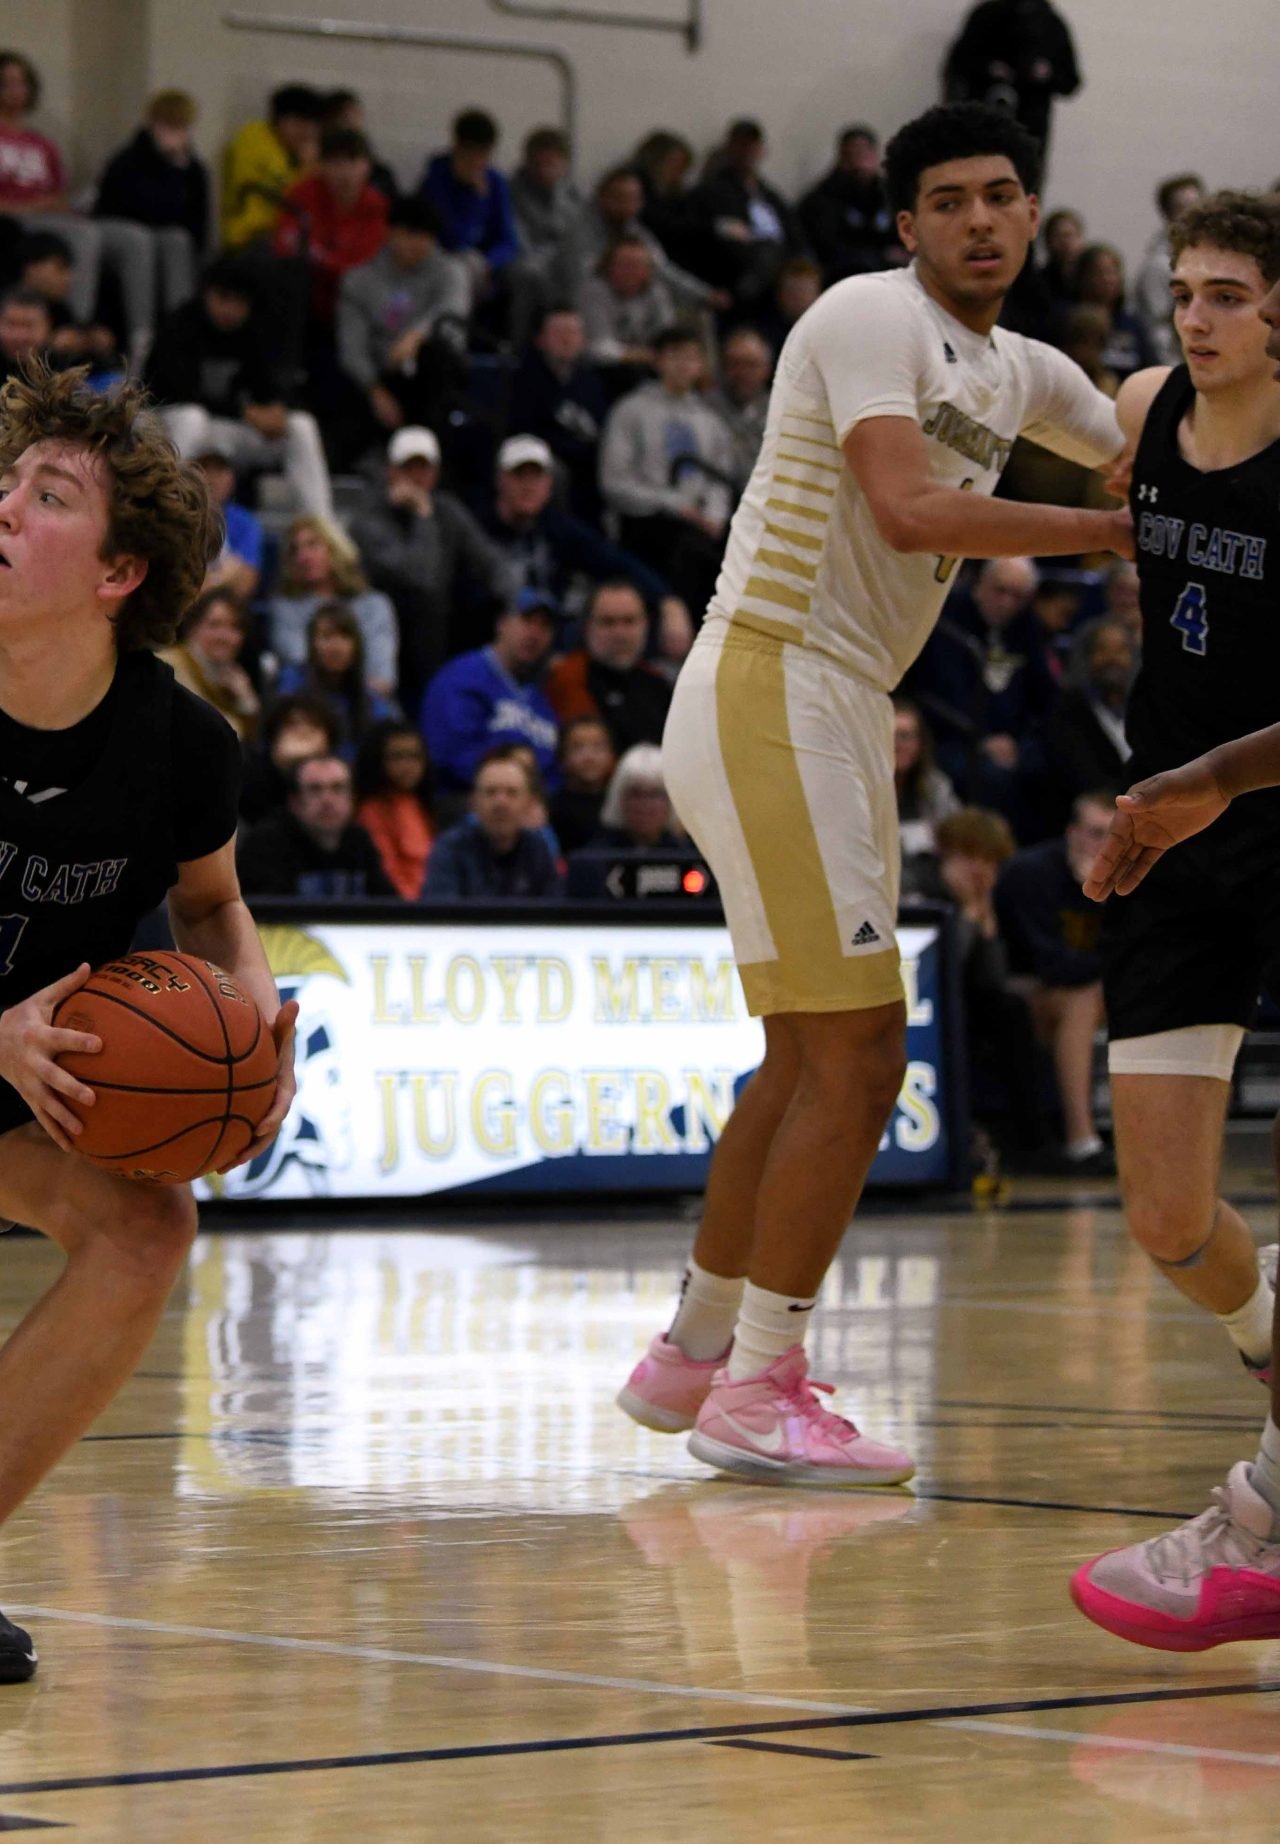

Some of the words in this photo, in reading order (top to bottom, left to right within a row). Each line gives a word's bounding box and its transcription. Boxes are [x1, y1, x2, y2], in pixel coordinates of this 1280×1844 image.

[1139, 511, 1185, 559] COV
[1187, 522, 1267, 580] CATH
[1170, 581, 1209, 656] 4
[21, 854, 128, 905] CATH
[370, 953, 574, 1024] LLOYD
[376, 1063, 939, 1177] JUGGERNS
